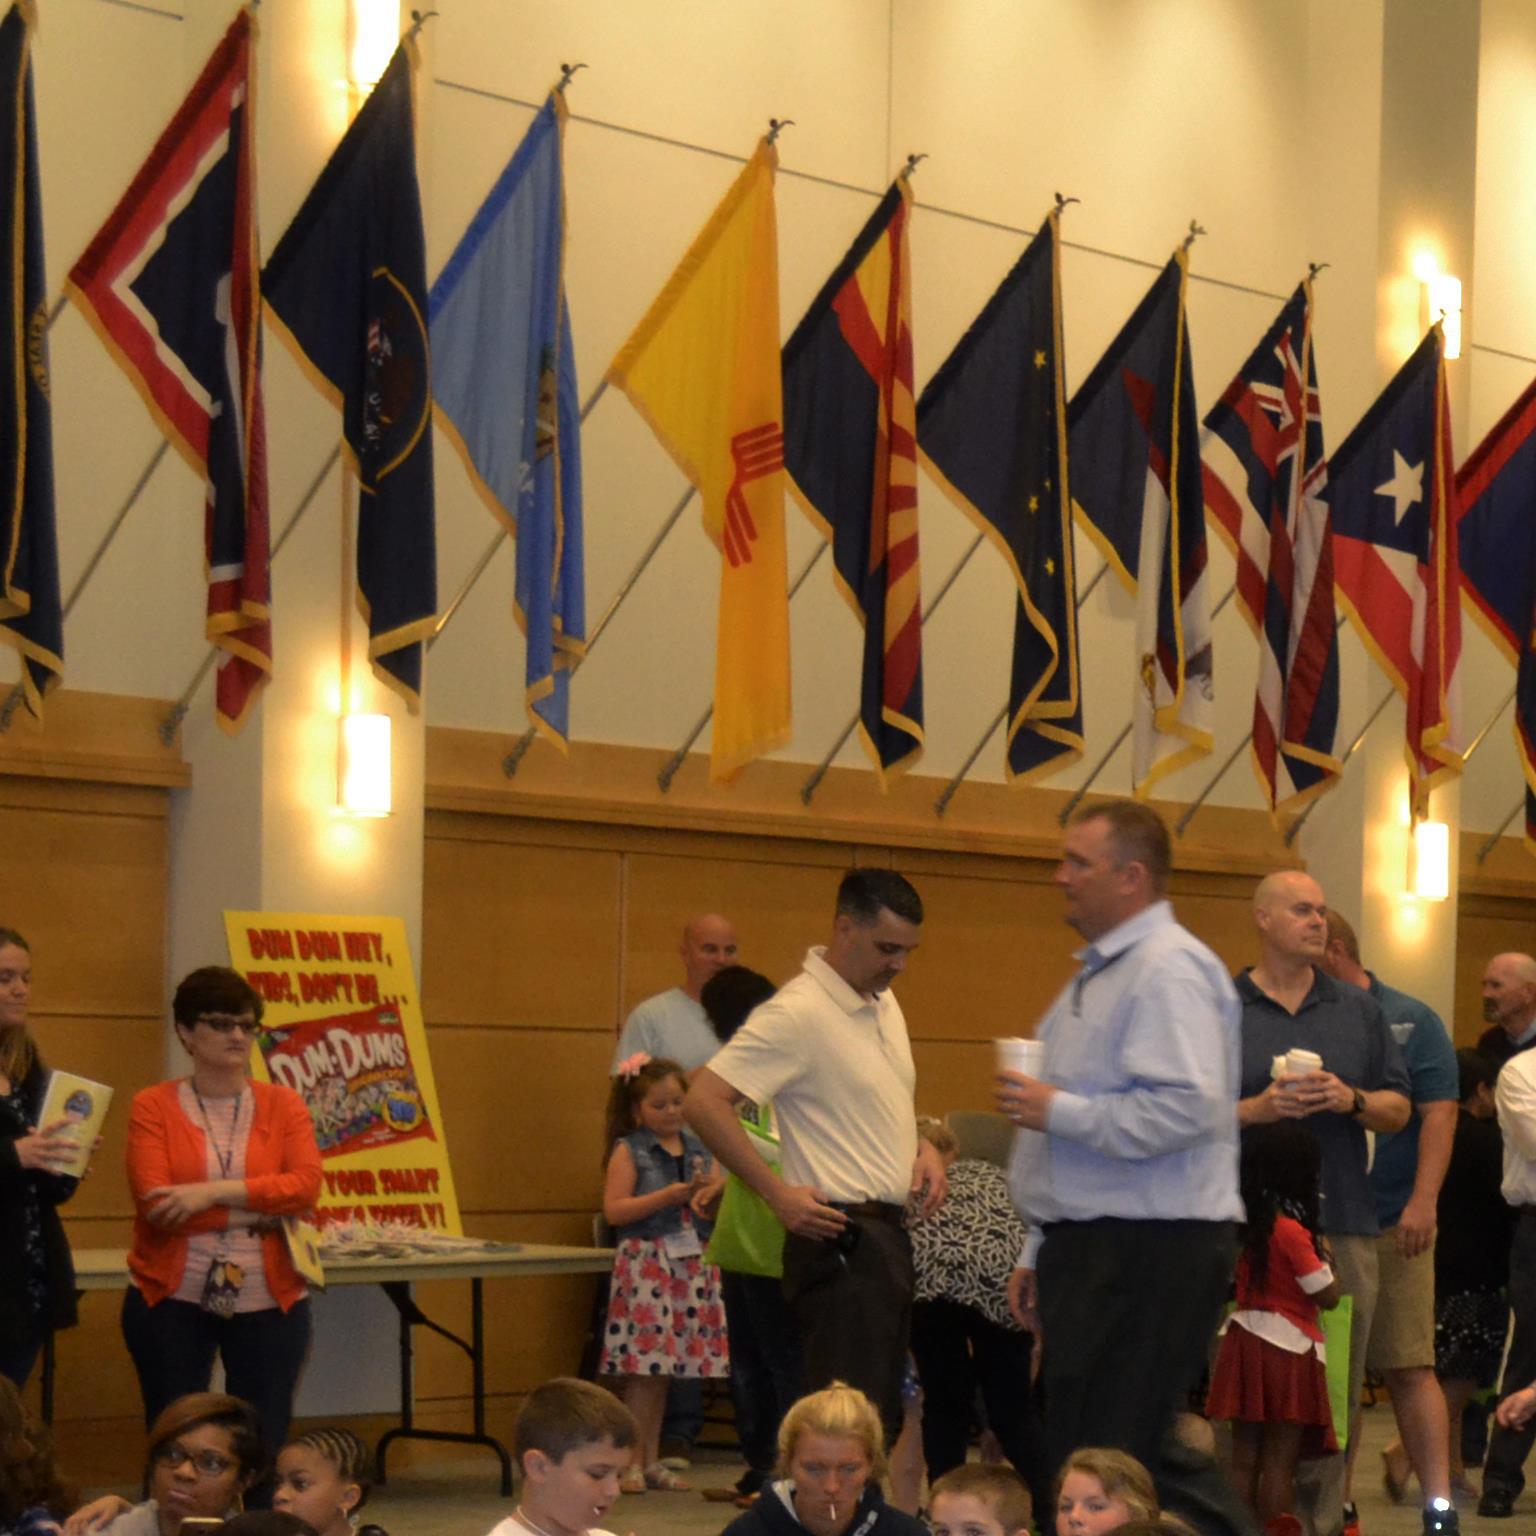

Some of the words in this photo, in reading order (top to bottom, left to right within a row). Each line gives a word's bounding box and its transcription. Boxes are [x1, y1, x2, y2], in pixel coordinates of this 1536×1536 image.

[246, 928, 294, 960] DUM
[295, 930, 343, 961] DUM
[323, 1169, 378, 1197] YOUR
[378, 1167, 440, 1195] SMART
